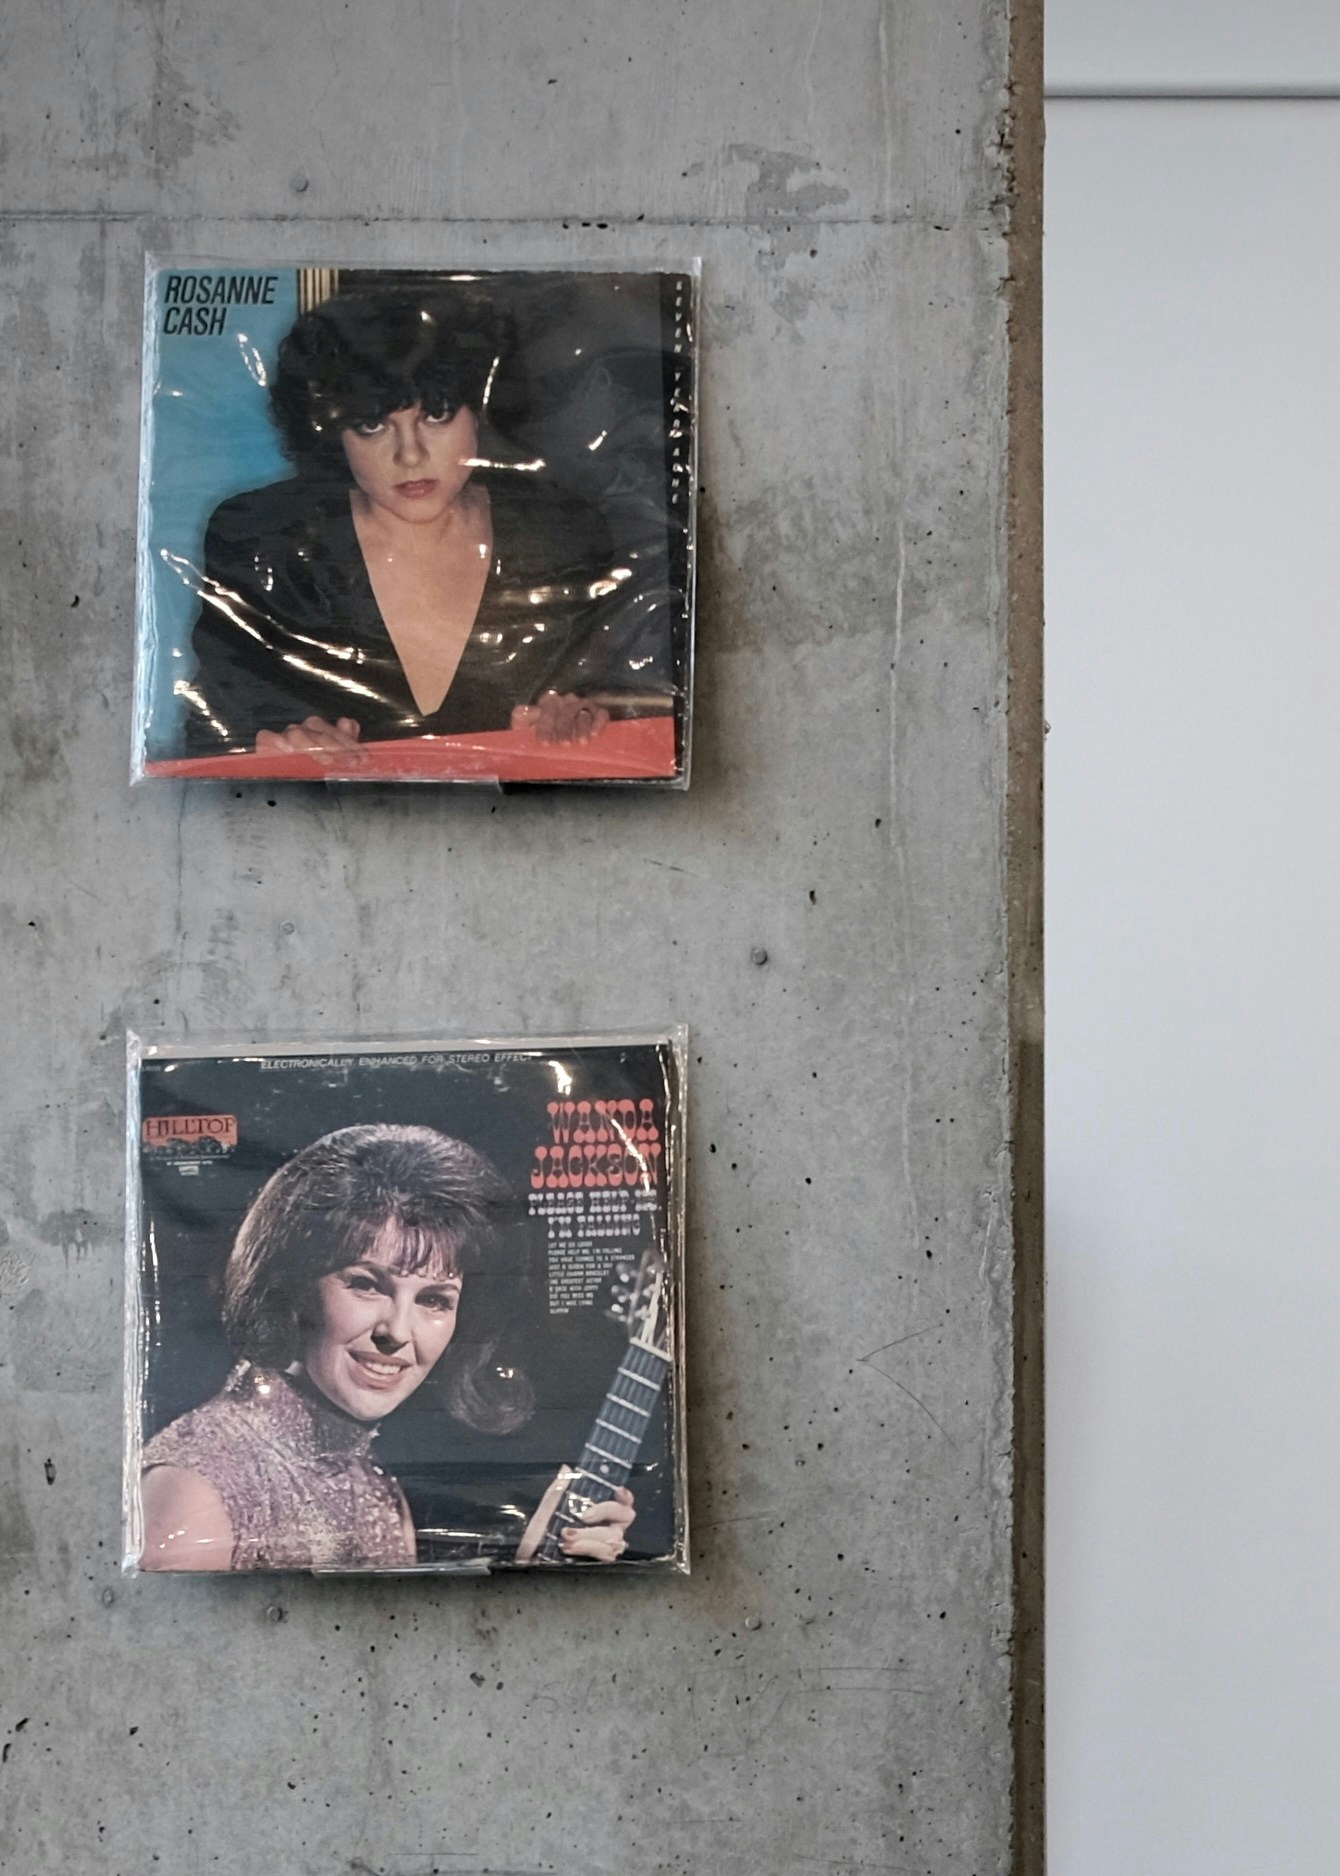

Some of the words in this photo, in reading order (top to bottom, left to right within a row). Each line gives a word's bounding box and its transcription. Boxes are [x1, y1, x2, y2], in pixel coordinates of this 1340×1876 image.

[164, 275, 279, 305] ROSANNE
[163, 306, 227, 336] CASH
[359, 1055, 417, 1067] ENHANCED
[420, 1054, 444, 1065] FOR
[449, 1053, 490, 1064] STEREO
[145, 1117, 234, 1137] HILLTOP
[547, 1099, 659, 1143] WANDA
[531, 1143, 661, 1188] JACKSON
